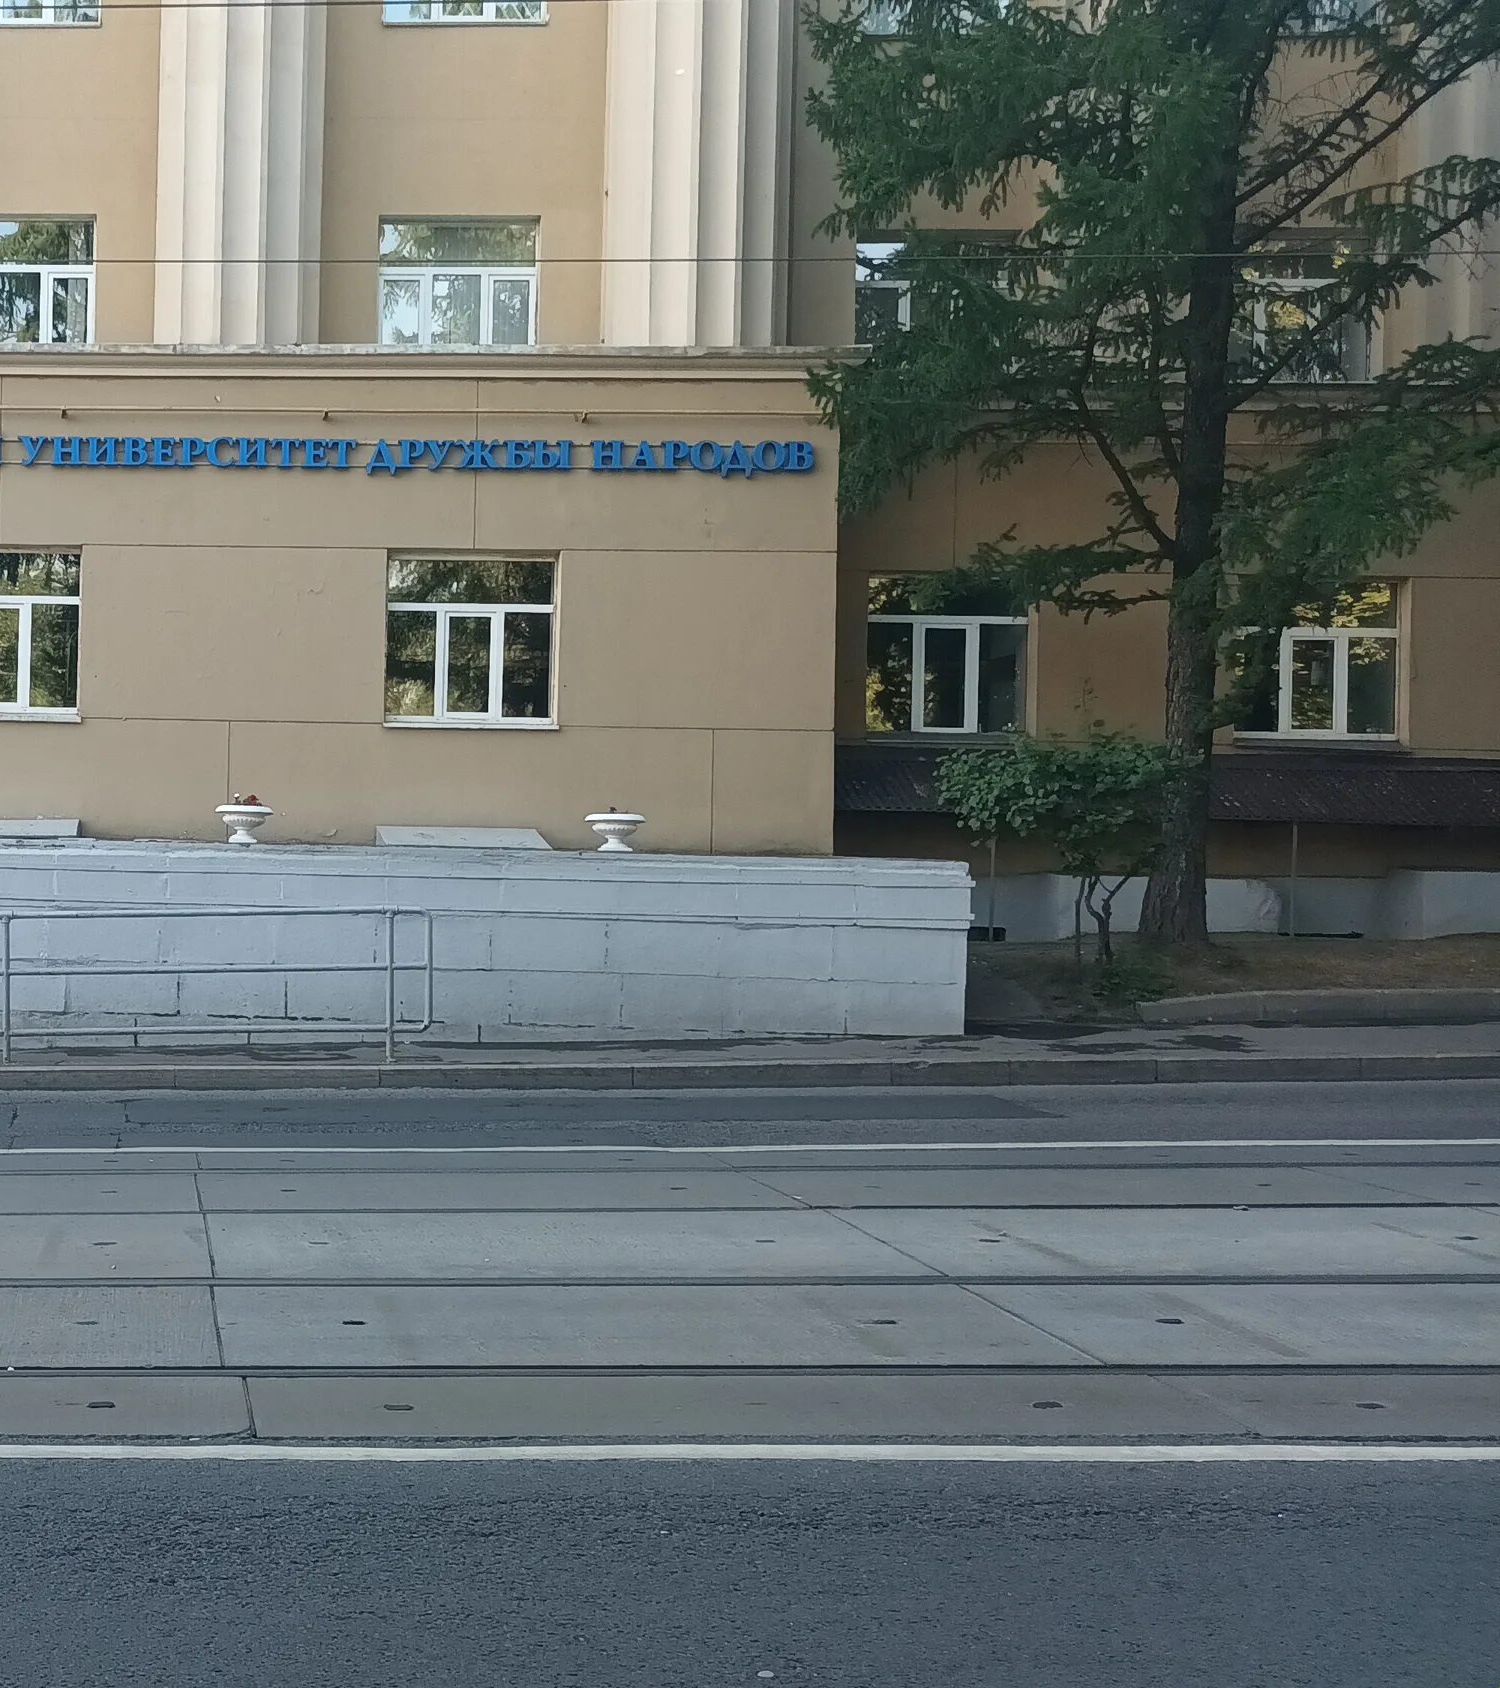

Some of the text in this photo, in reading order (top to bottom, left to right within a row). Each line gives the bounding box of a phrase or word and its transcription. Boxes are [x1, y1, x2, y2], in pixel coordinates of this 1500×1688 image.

[18, 435, 357, 469] УНИВЕРСИТЕТ
[366, 438, 573, 476] ДРУЖБЫ
[590, 439, 816, 479] НАРОДОВ
